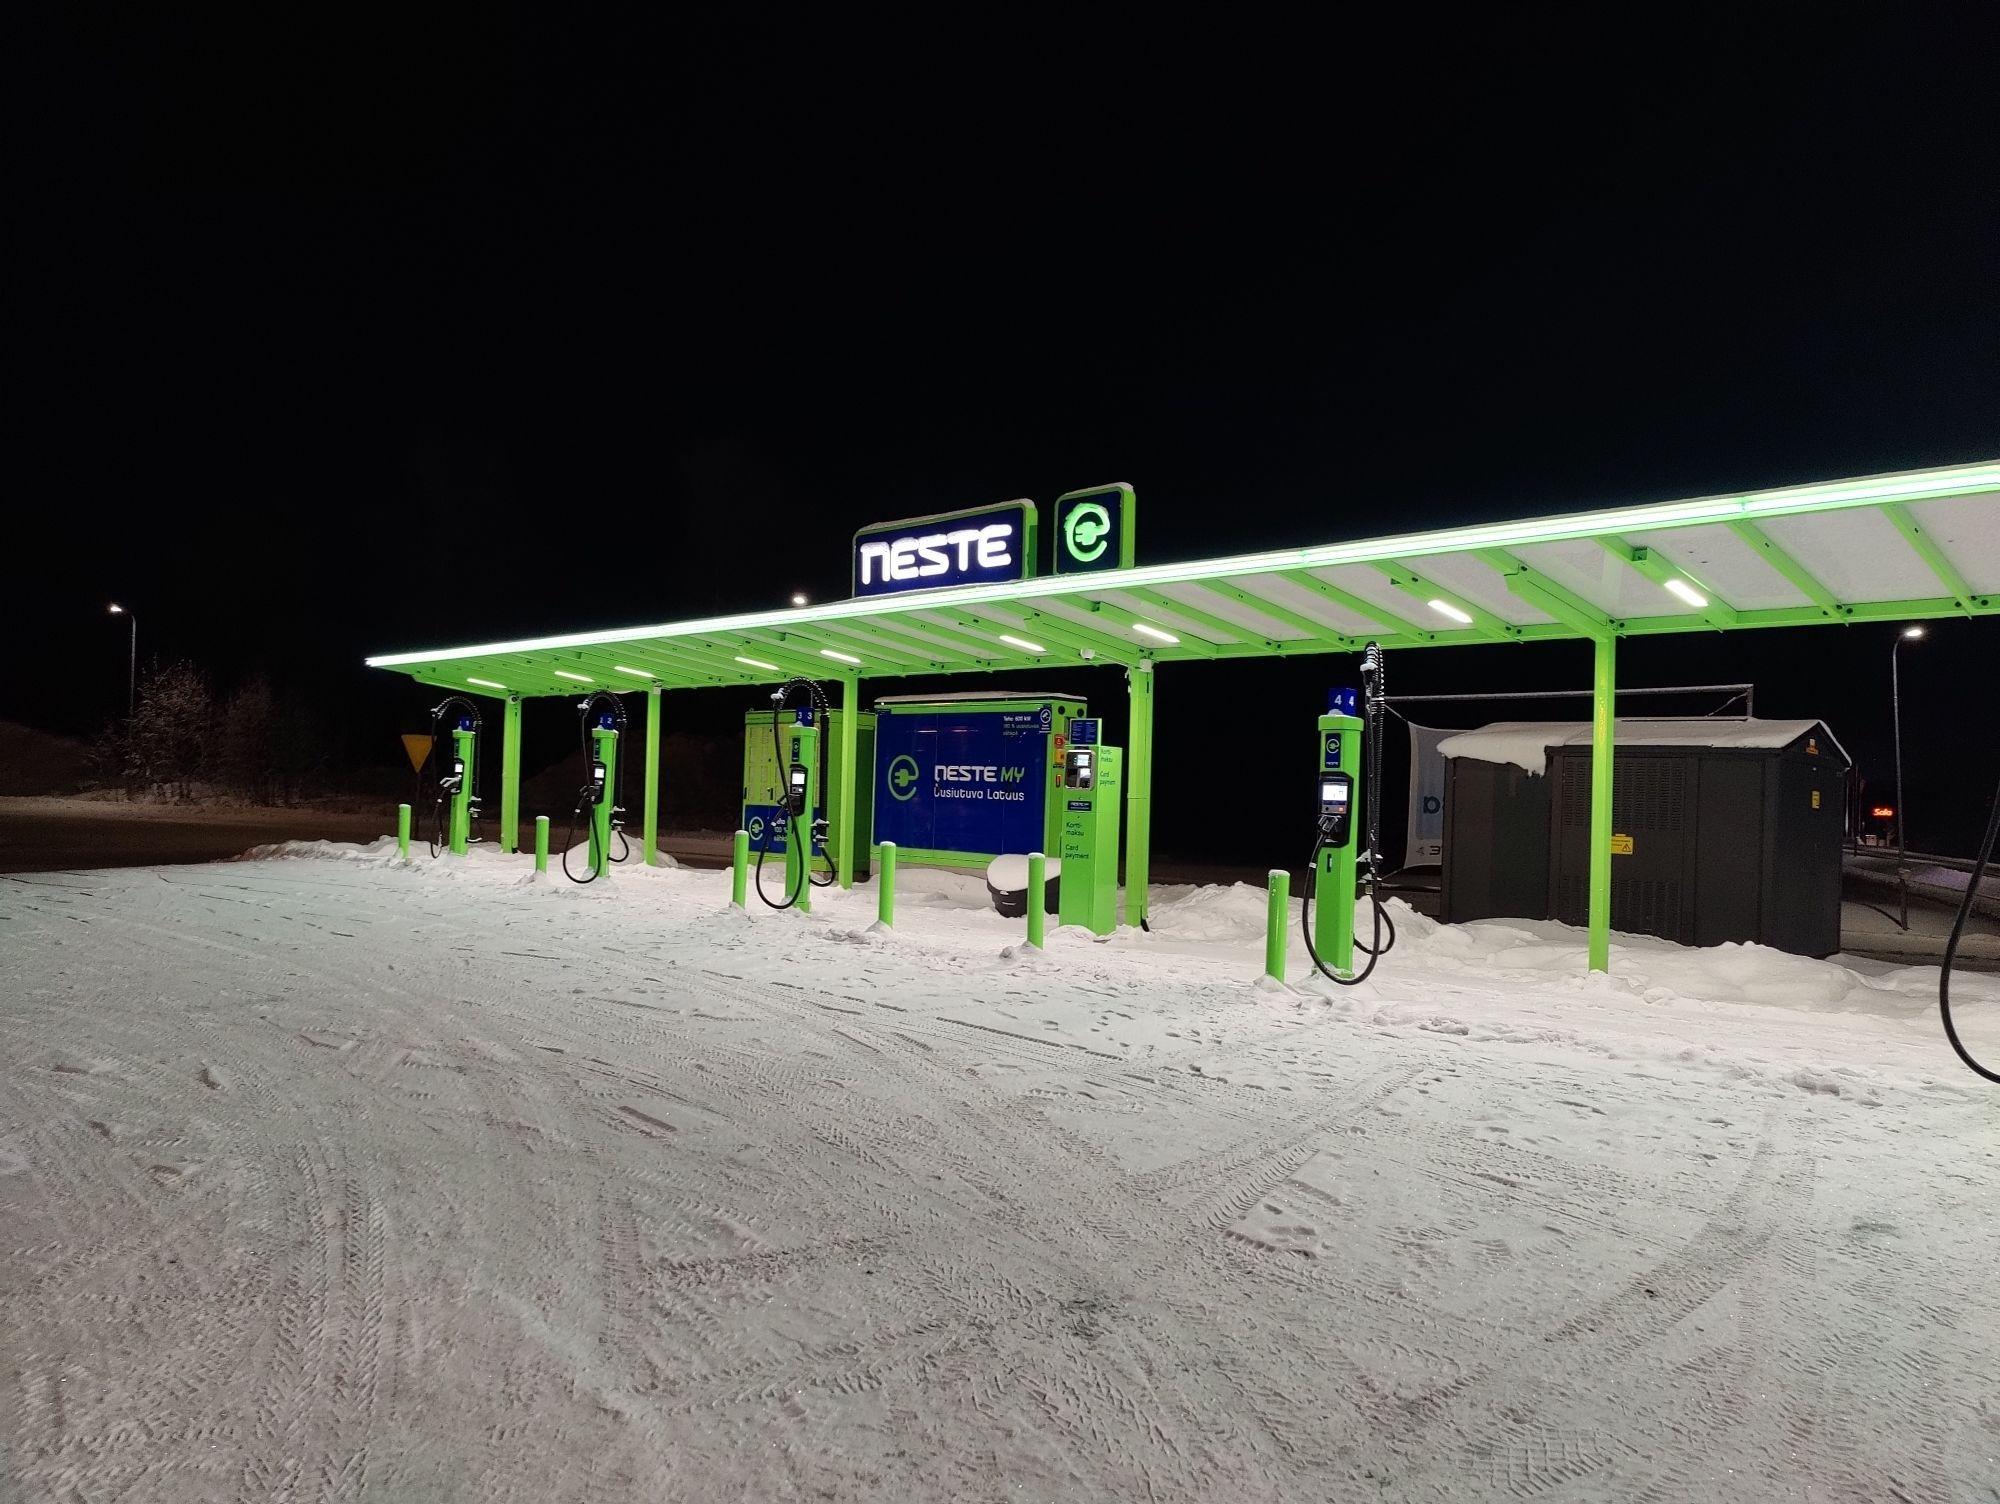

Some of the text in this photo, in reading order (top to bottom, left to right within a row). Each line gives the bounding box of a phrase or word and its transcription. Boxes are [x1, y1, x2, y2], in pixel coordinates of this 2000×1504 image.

[860, 523, 1013, 585] NESTE
[1334, 694, 1342, 705] 4
[1348, 695, 1354, 706] 4
[934, 765, 1025, 783] NESTE MY
[934, 786, 1025, 801] Uusiutuva Lataus
[1065, 852, 1089, 860] payment
